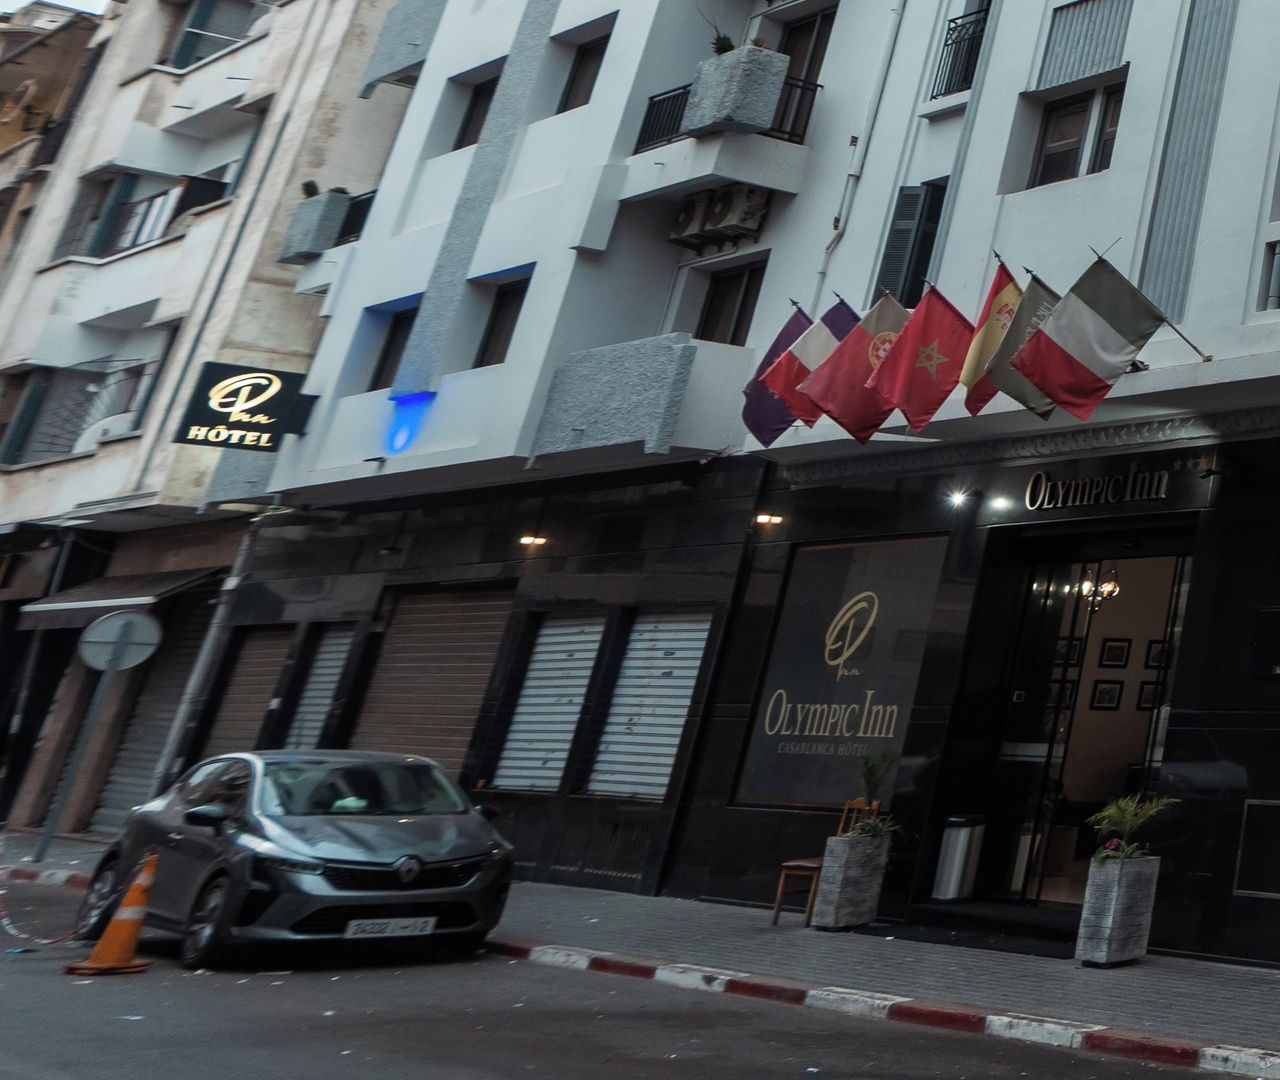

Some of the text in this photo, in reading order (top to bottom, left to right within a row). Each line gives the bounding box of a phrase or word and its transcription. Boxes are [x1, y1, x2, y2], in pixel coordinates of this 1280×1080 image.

[186, 425, 274, 447] HÔTEL
[1025, 462, 1169, 511] OLYMPIC Inn
[764, 689, 898, 738] OLYMPIC Inn
[777, 741, 835, 755] CASABLANCA
